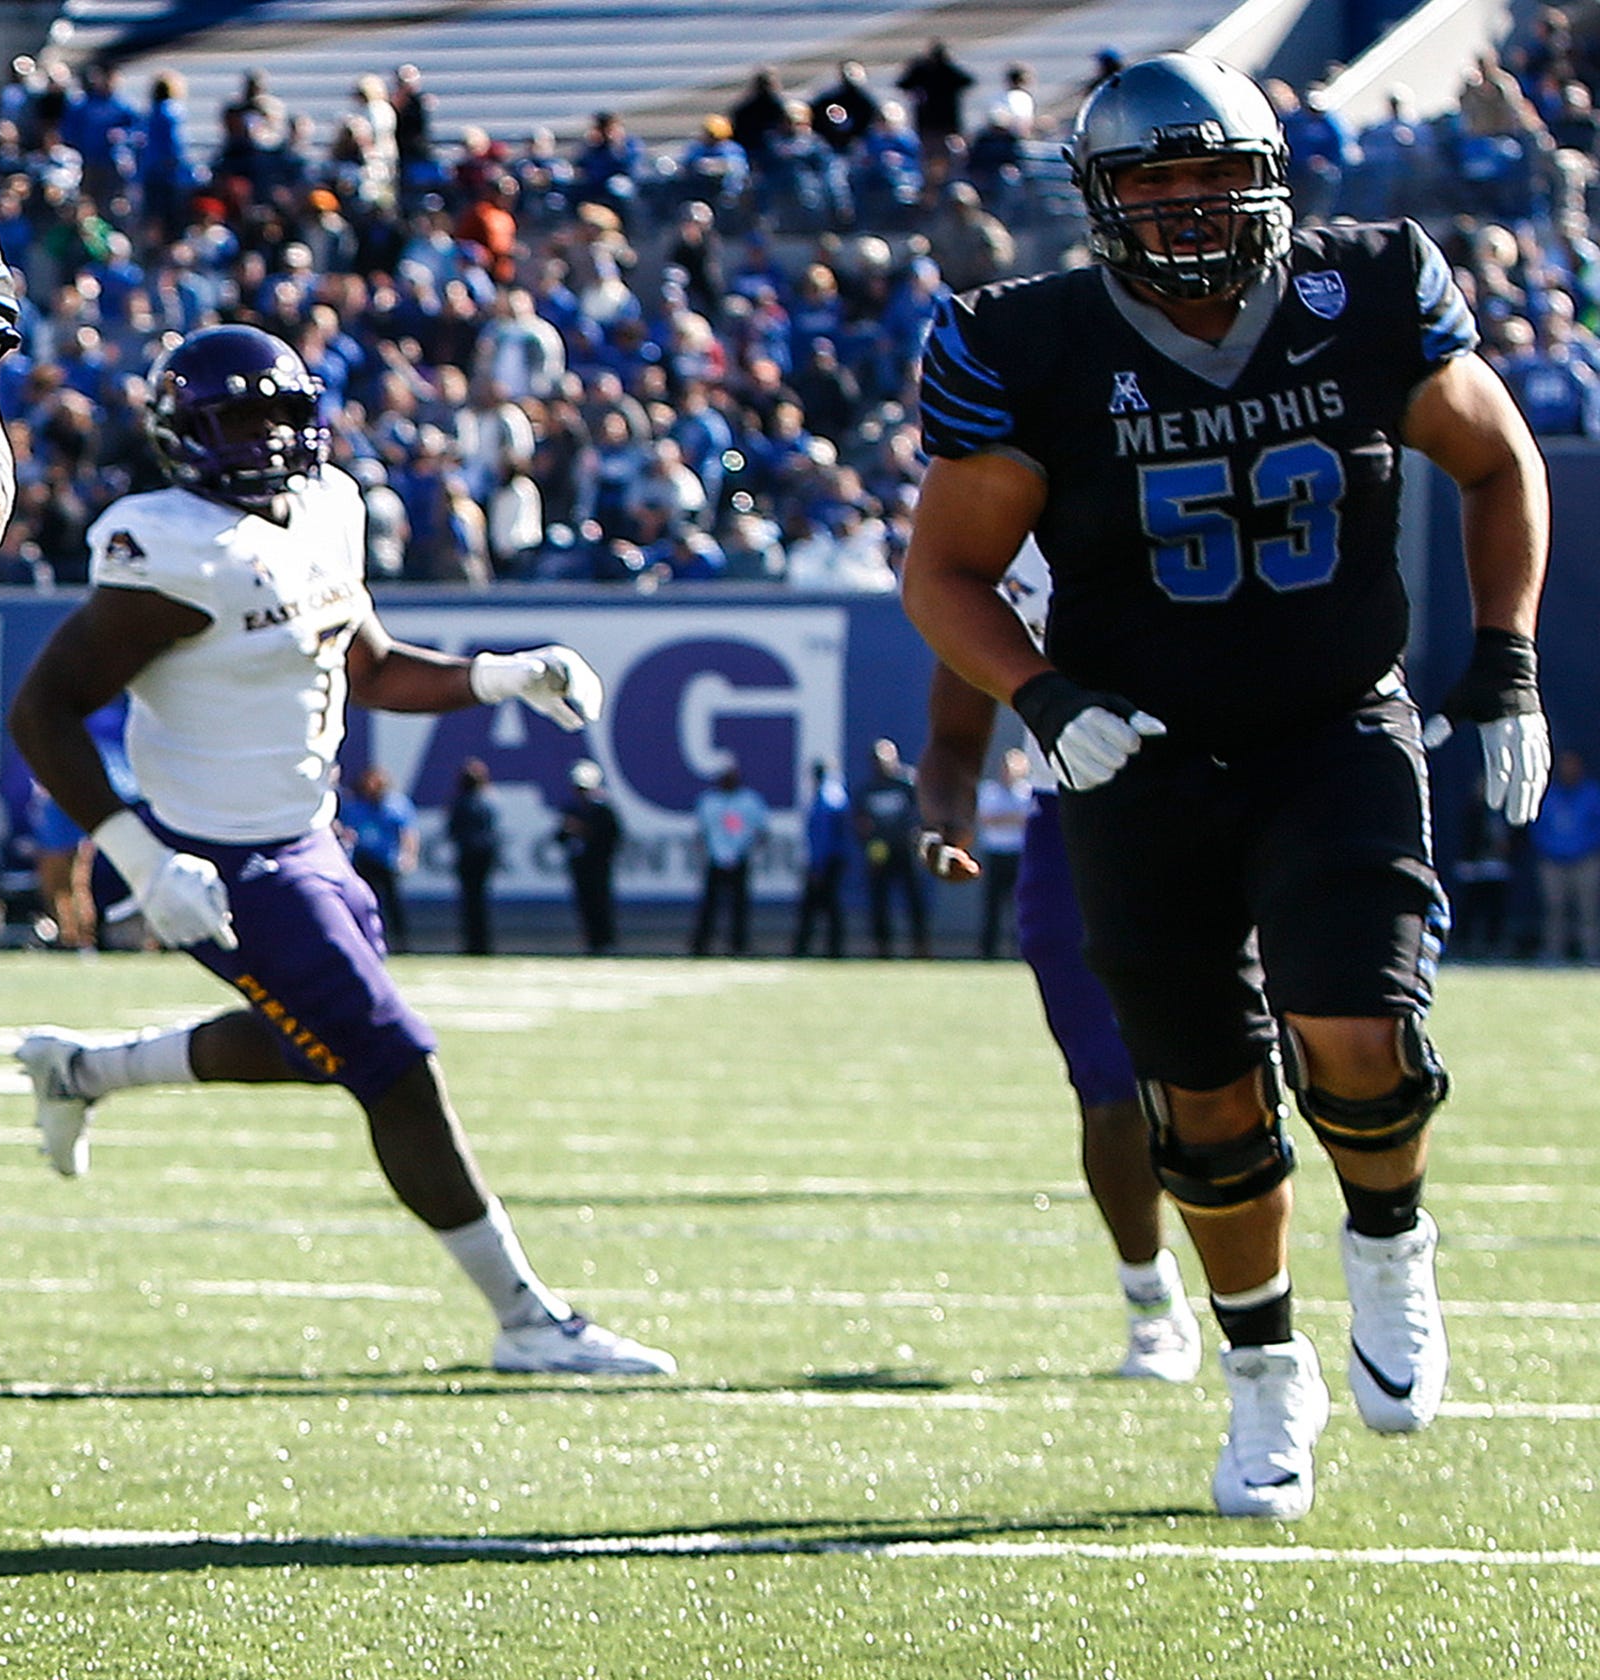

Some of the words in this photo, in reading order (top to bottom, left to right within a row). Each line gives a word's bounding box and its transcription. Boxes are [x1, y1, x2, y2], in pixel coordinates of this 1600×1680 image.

[1113, 380, 1345, 457] MEMPHIS
[1136, 435, 1347, 602] 53
[345, 630, 803, 816] AG
[234, 973, 346, 1076] PIRATES
